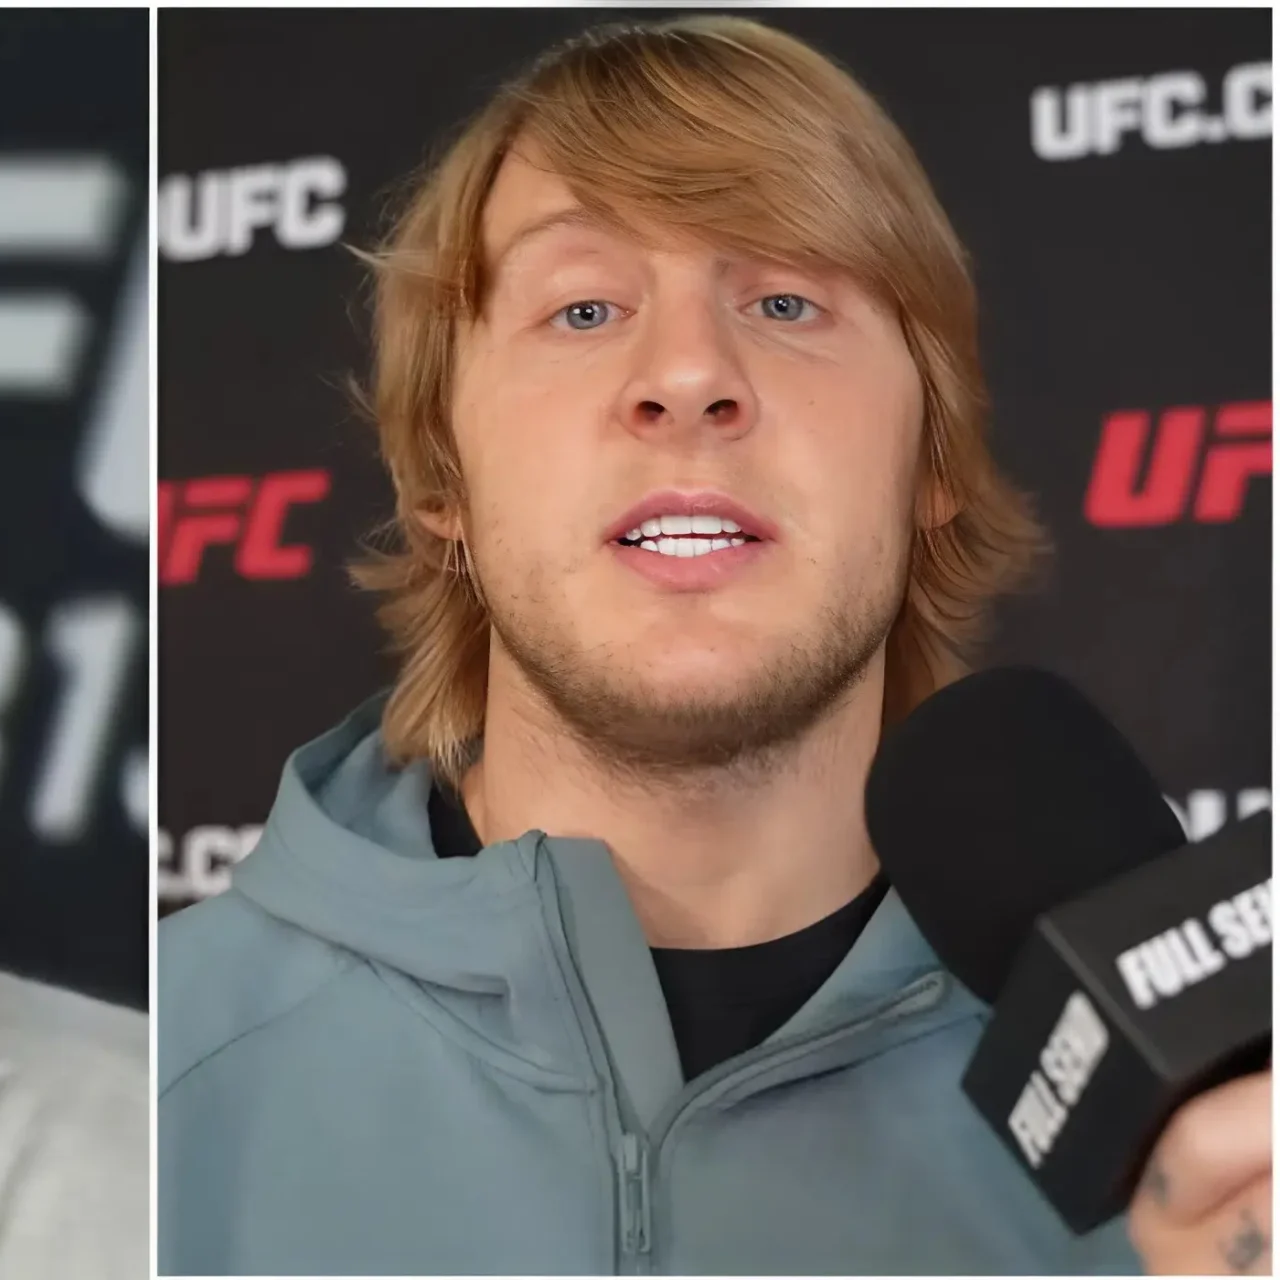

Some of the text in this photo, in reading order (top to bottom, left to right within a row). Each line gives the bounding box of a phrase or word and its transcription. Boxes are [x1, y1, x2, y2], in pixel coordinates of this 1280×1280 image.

[158, 157, 347, 261] UFC
[158, 469, 331, 586] FC
[1116, 877, 1272, 1009] FULL SE
